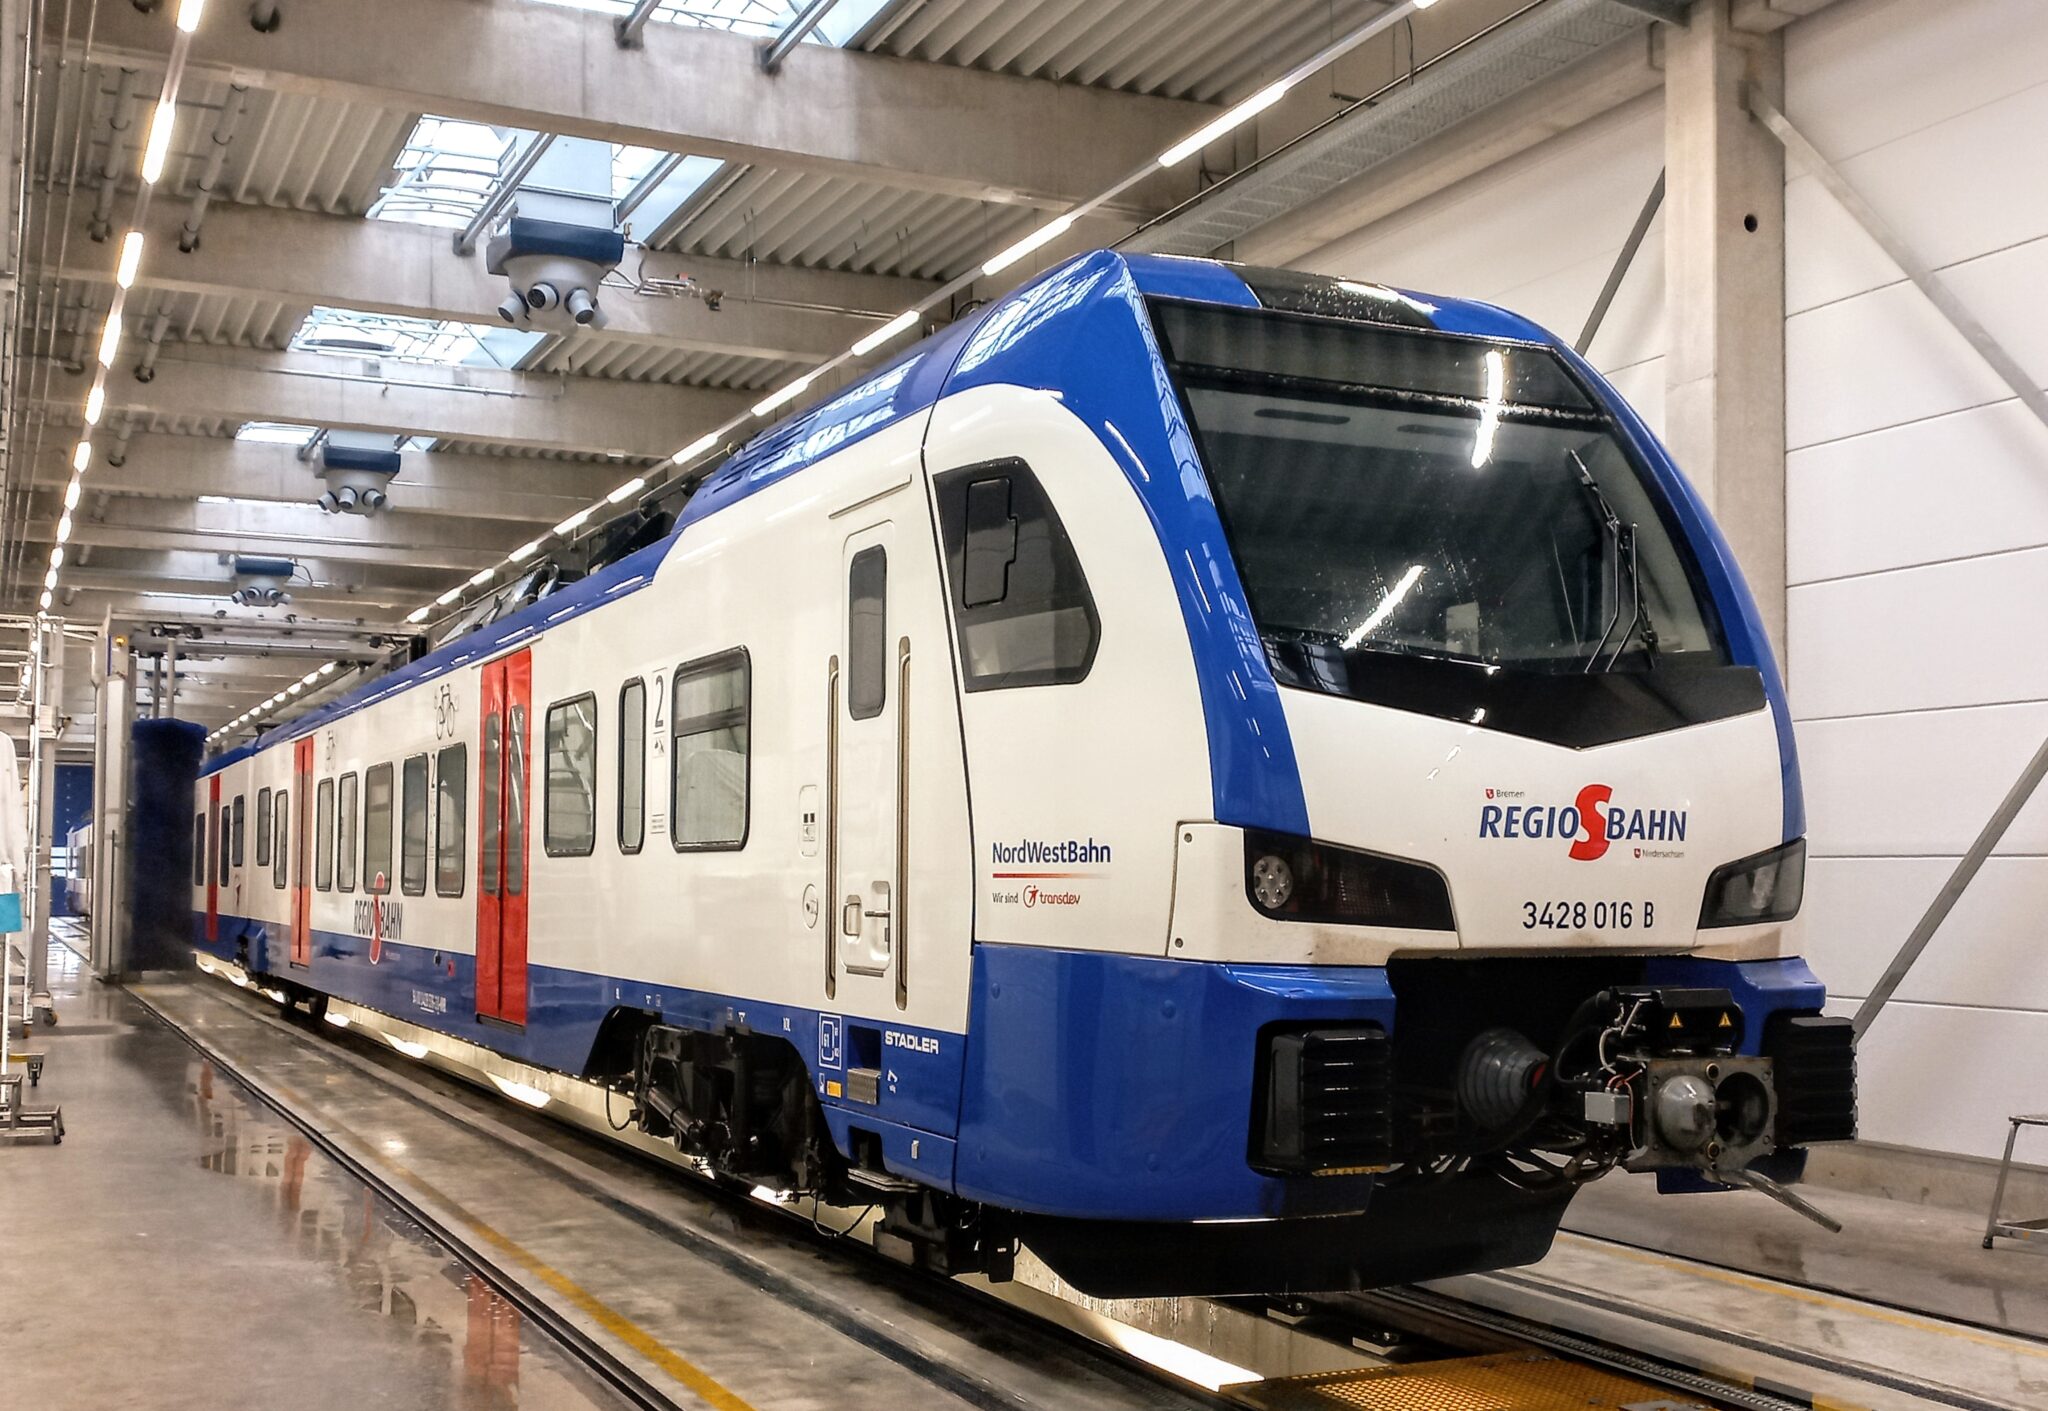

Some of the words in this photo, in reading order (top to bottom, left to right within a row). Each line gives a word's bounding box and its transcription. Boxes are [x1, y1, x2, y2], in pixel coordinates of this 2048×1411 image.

[1496, 788, 1524, 798] Bremen
[992, 838, 1111, 863] NordWestBahn
[992, 893, 1004, 904] Wir
[1004, 893, 1019, 904] sind
[1039, 892, 1081, 905] transdev
[1522, 901, 1587, 929] 3428
[1593, 901, 1633, 929] 016
[1643, 902, 1654, 928] B
[885, 1030, 939, 1054] STADLER
